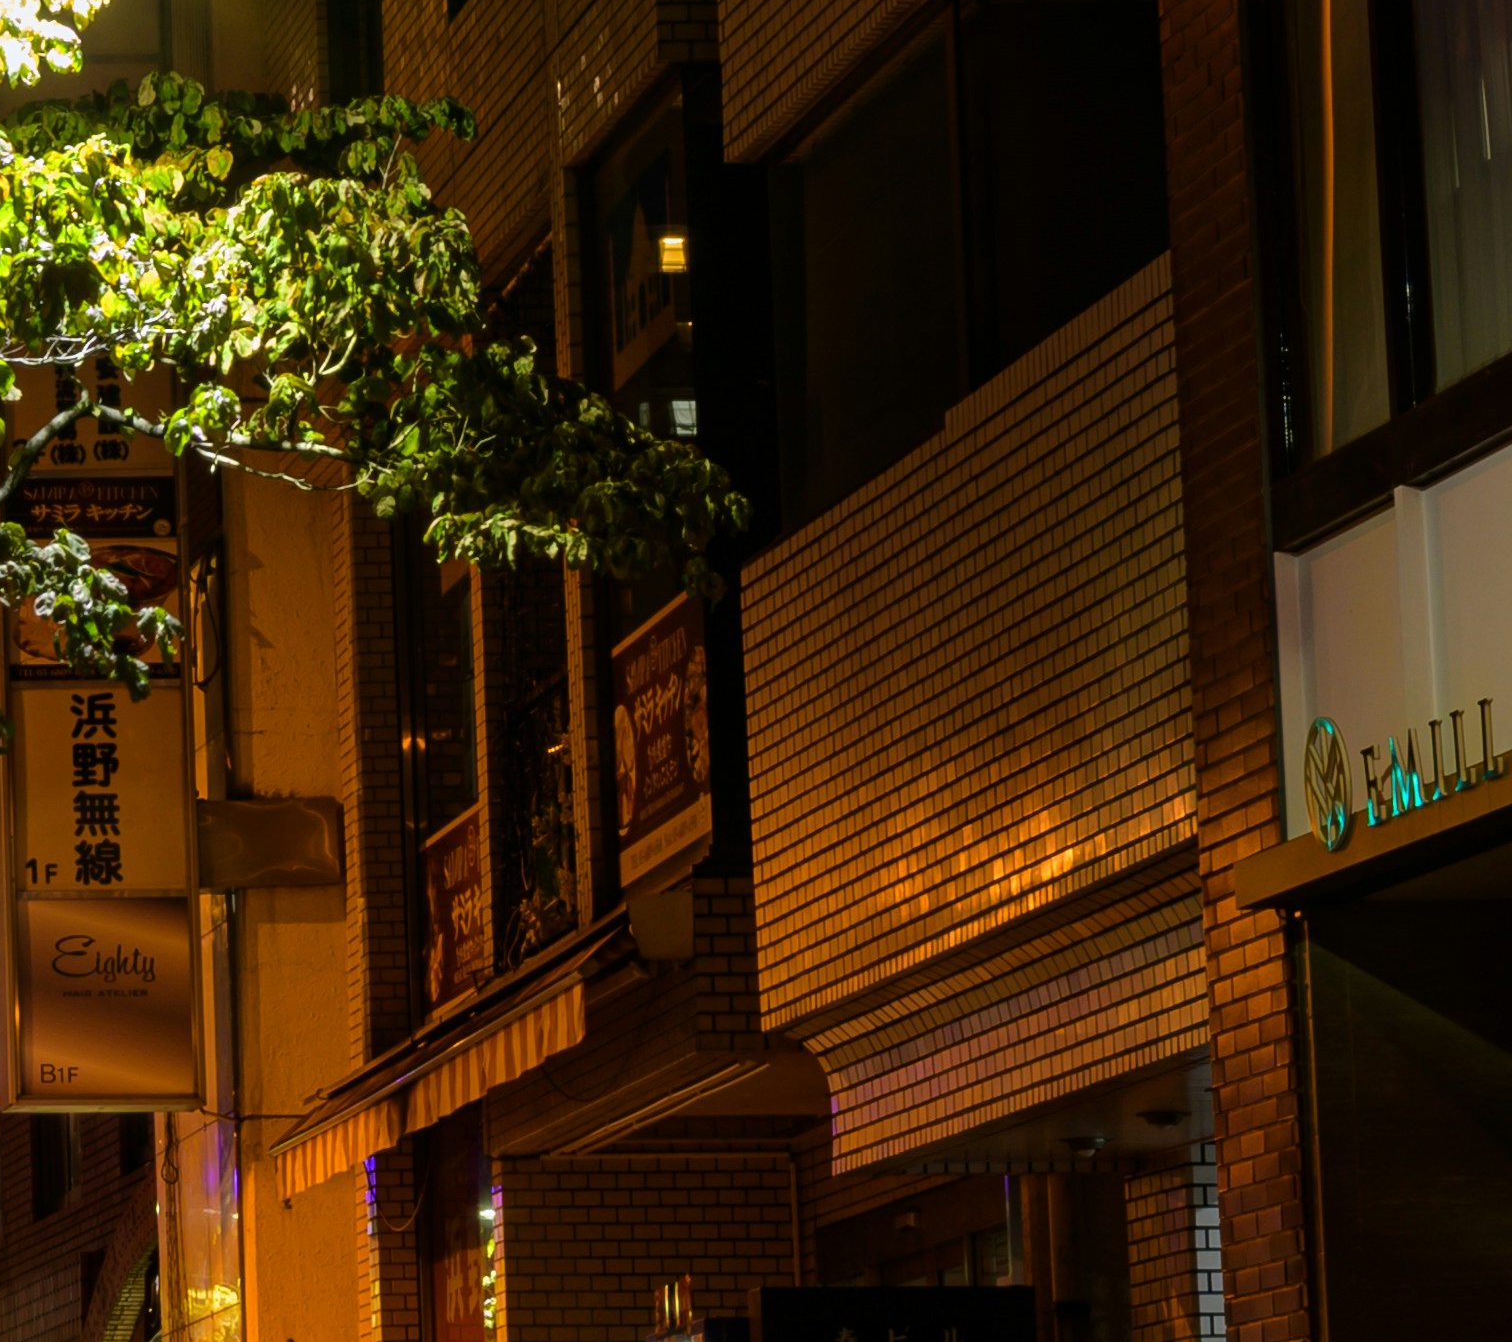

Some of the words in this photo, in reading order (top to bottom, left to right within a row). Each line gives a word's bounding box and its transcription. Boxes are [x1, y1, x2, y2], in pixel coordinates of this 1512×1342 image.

[30, 503, 81, 522] サミラ
[85, 503, 153, 521] キッチン
[70, 692, 124, 886] 浜野無線
[24, 857, 59, 886] 1F
[50, 934, 157, 983] Eighty
[40, 1063, 79, 1085] B1F
